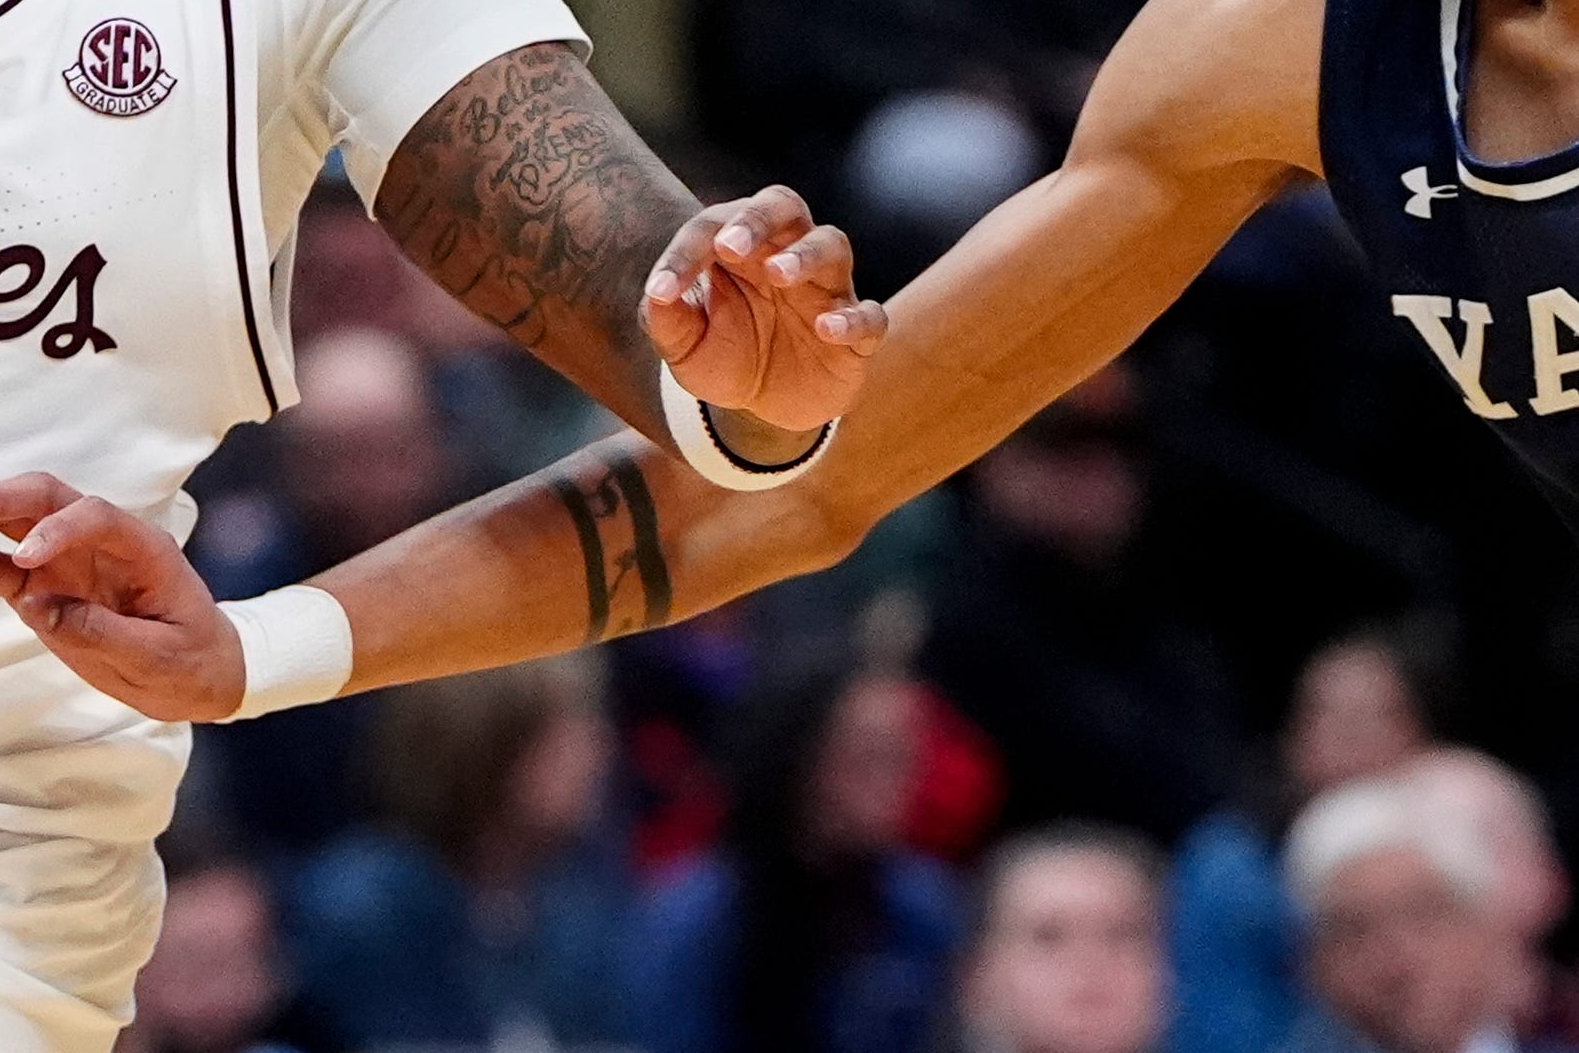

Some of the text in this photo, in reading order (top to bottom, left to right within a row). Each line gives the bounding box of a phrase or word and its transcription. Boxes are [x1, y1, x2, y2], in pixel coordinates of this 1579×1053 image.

[89, 24, 153, 89] SEC
[76, 82, 160, 113] GRADUATE
[1391, 287, 1579, 420] YA
